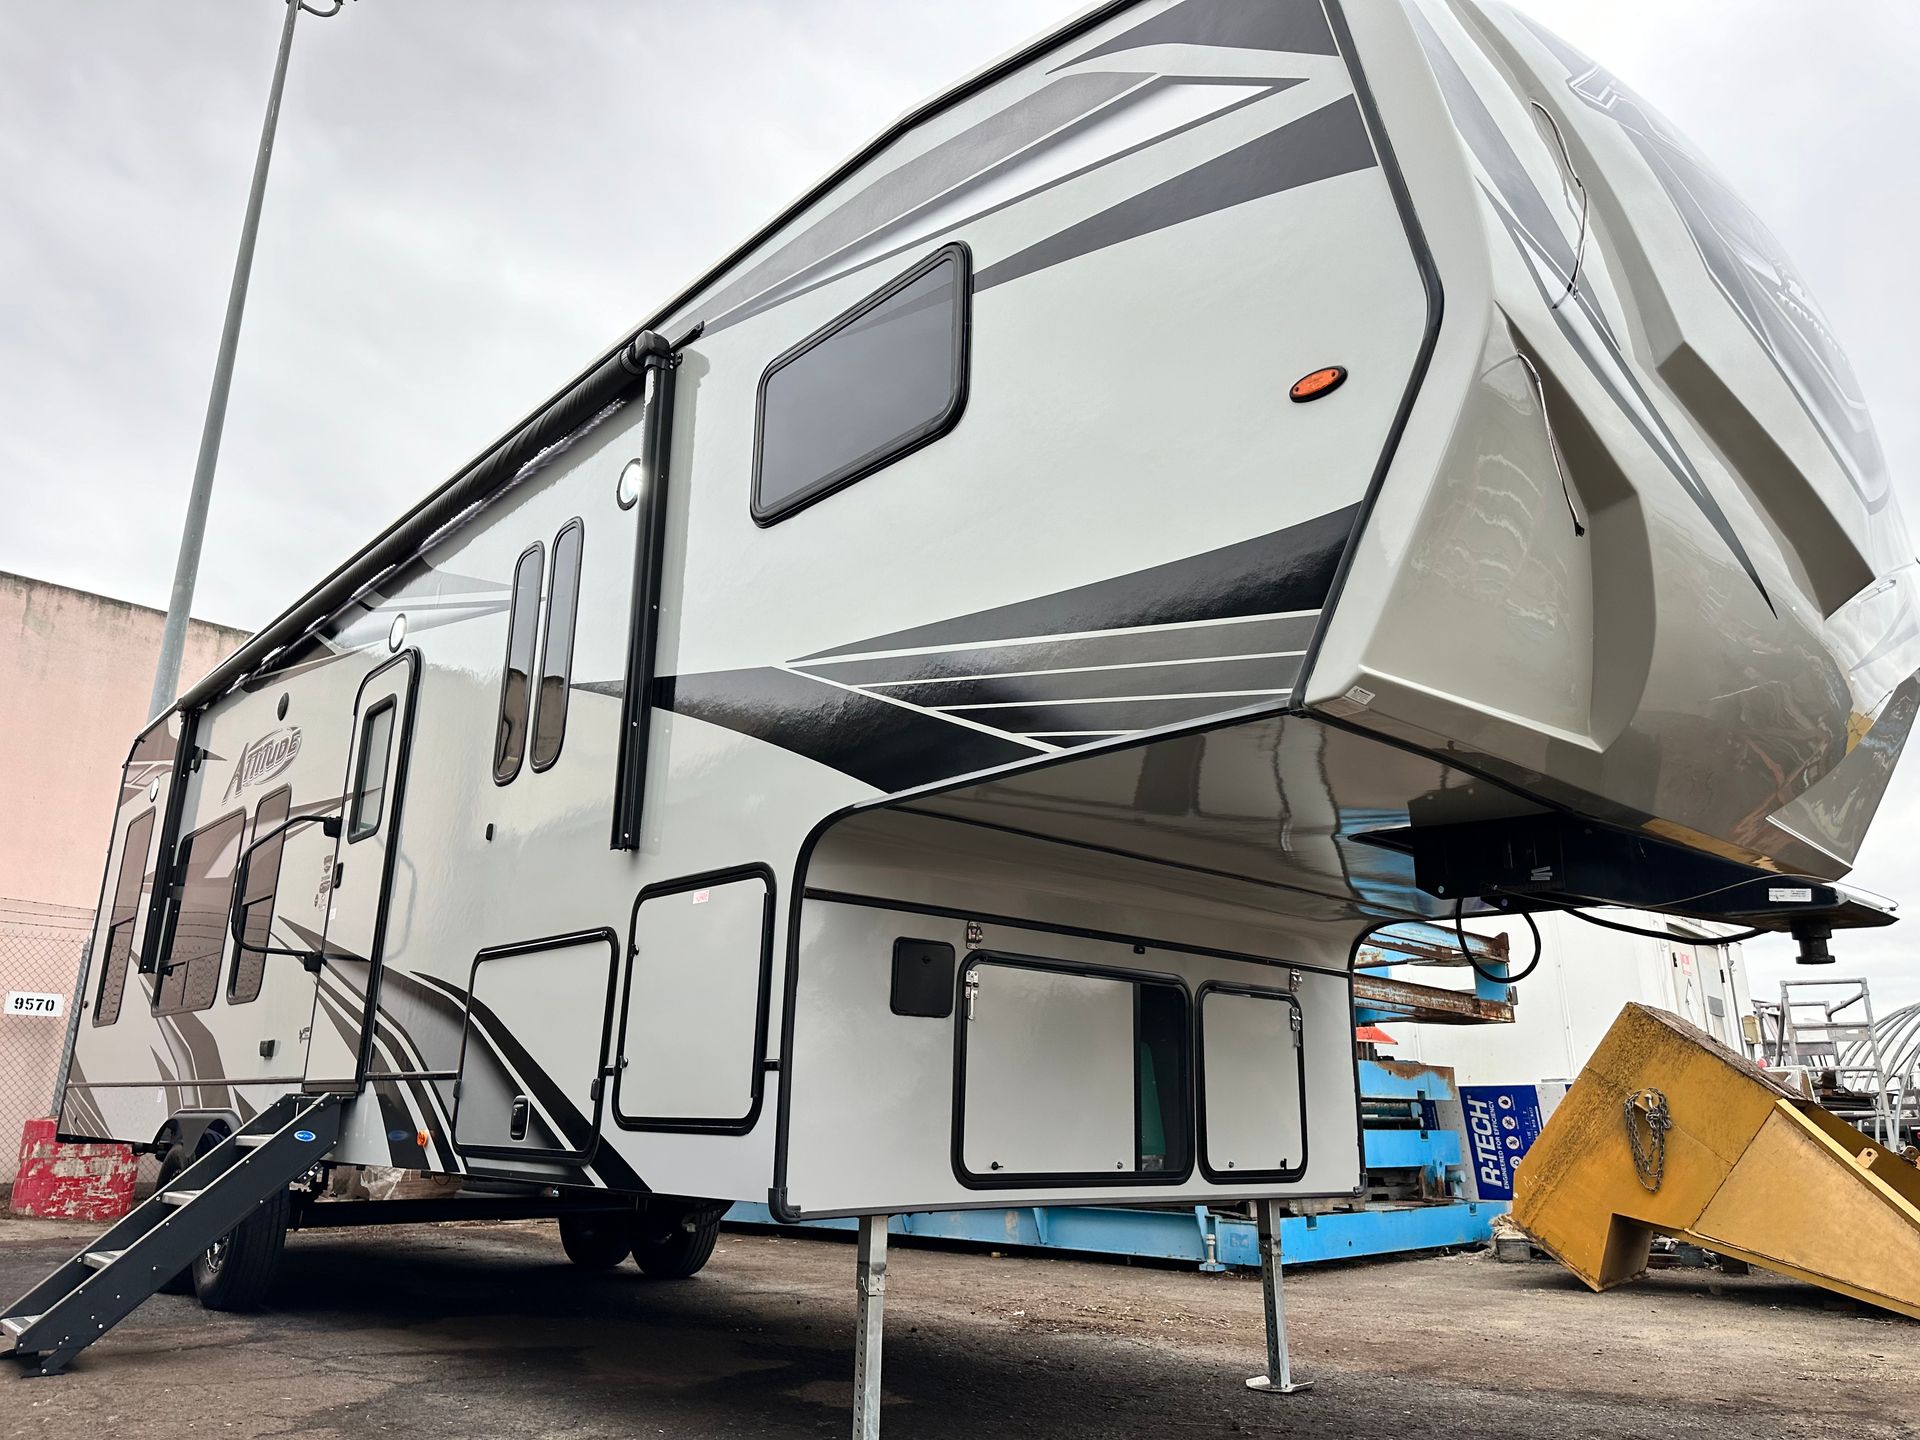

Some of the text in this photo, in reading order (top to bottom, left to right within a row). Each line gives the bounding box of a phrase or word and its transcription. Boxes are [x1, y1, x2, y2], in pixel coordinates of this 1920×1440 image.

[14, 997, 55, 1012] 9570
[1488, 1100, 1499, 1134] EFFICIENCY
[1467, 1099, 1502, 1187] R-TECH
[1498, 1150, 1510, 1189] ENGINEERED
